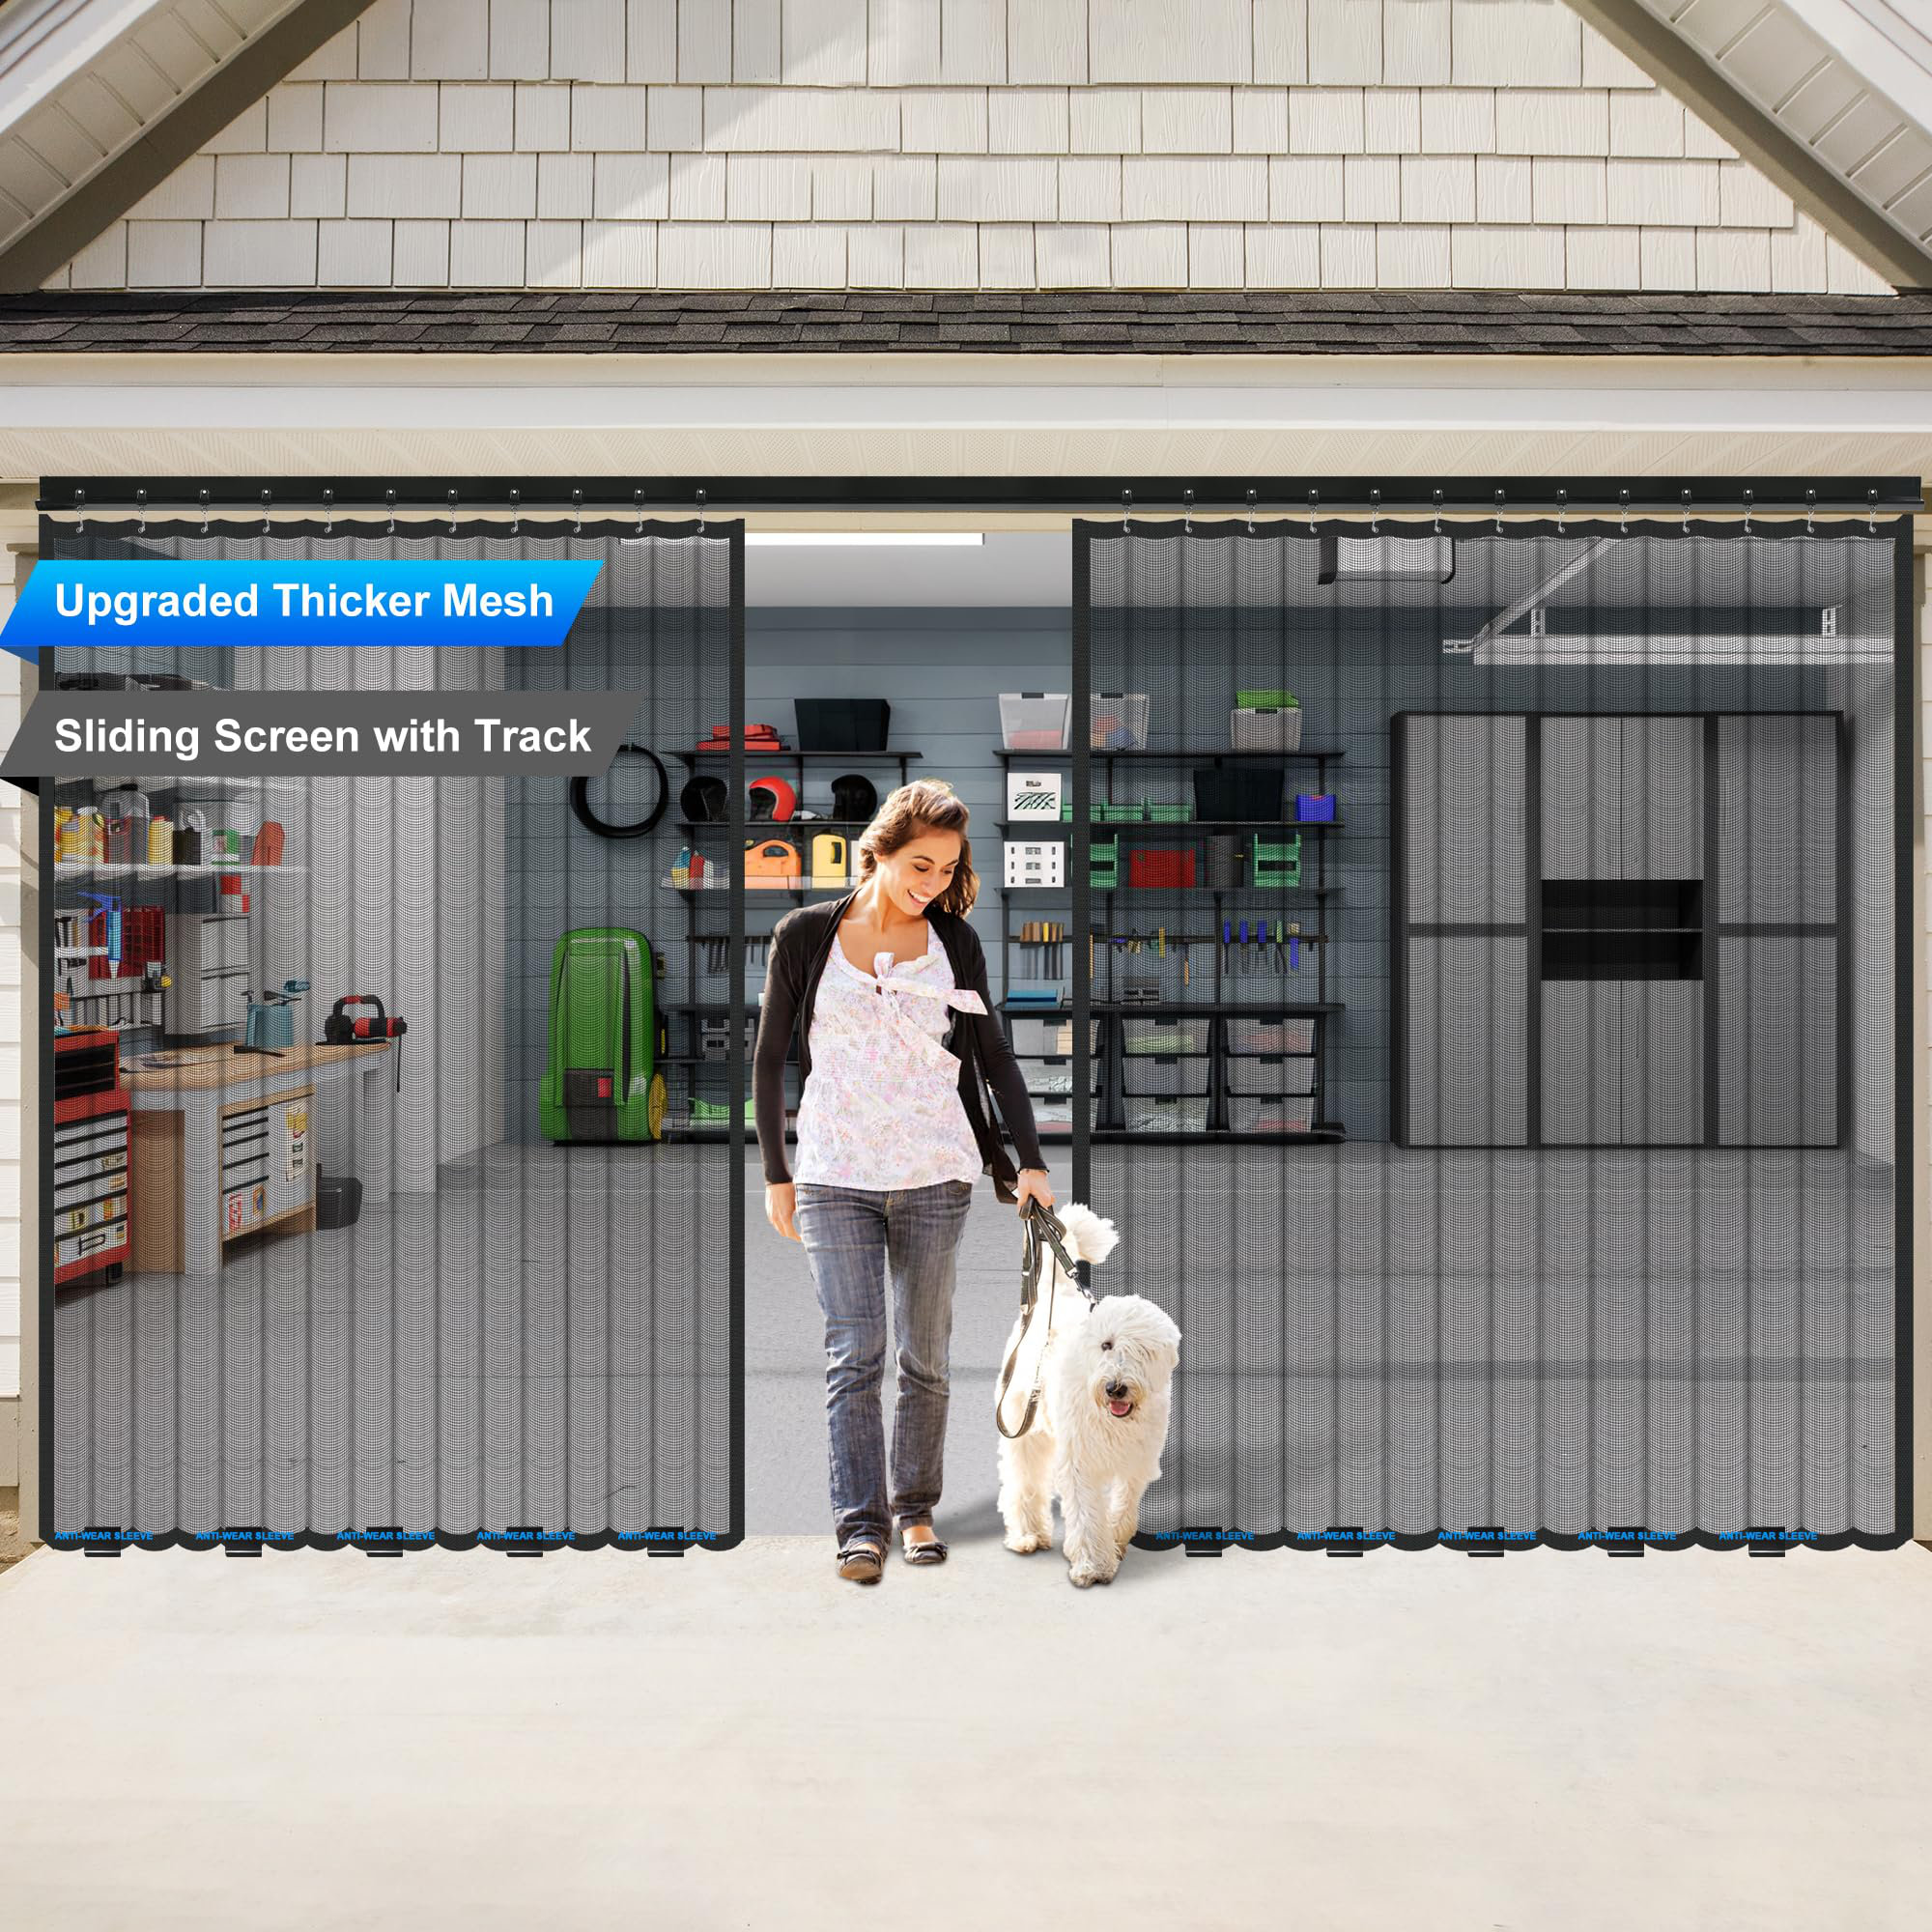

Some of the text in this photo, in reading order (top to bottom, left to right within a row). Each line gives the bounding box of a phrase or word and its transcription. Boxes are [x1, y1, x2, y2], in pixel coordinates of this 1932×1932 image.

[54, 1530, 154, 1541] ANTI-WEAR SLEEVE
[195, 1530, 295, 1541] ANTI-WEAR SLEEVE
[335, 1530, 435, 1541] ANTI-WEAR SLEEVE
[476, 1530, 576, 1541] ANTI-WEAR SLEEVE
[617, 1530, 717, 1541] ANTI-WEAR SLEEVE
[1155, 1530, 1255, 1541] ANTI-WEAR SLEEVE
[1296, 1530, 1396, 1541] ANTI-WEAR SLEEVE
[1437, 1530, 1537, 1541] ANTI-WEAR SLEEVE
[1577, 1530, 1677, 1541] ANTI-WEAR SLEEVE
[1719, 1530, 1818, 1541] ANTI-WEAR SLEEVE
